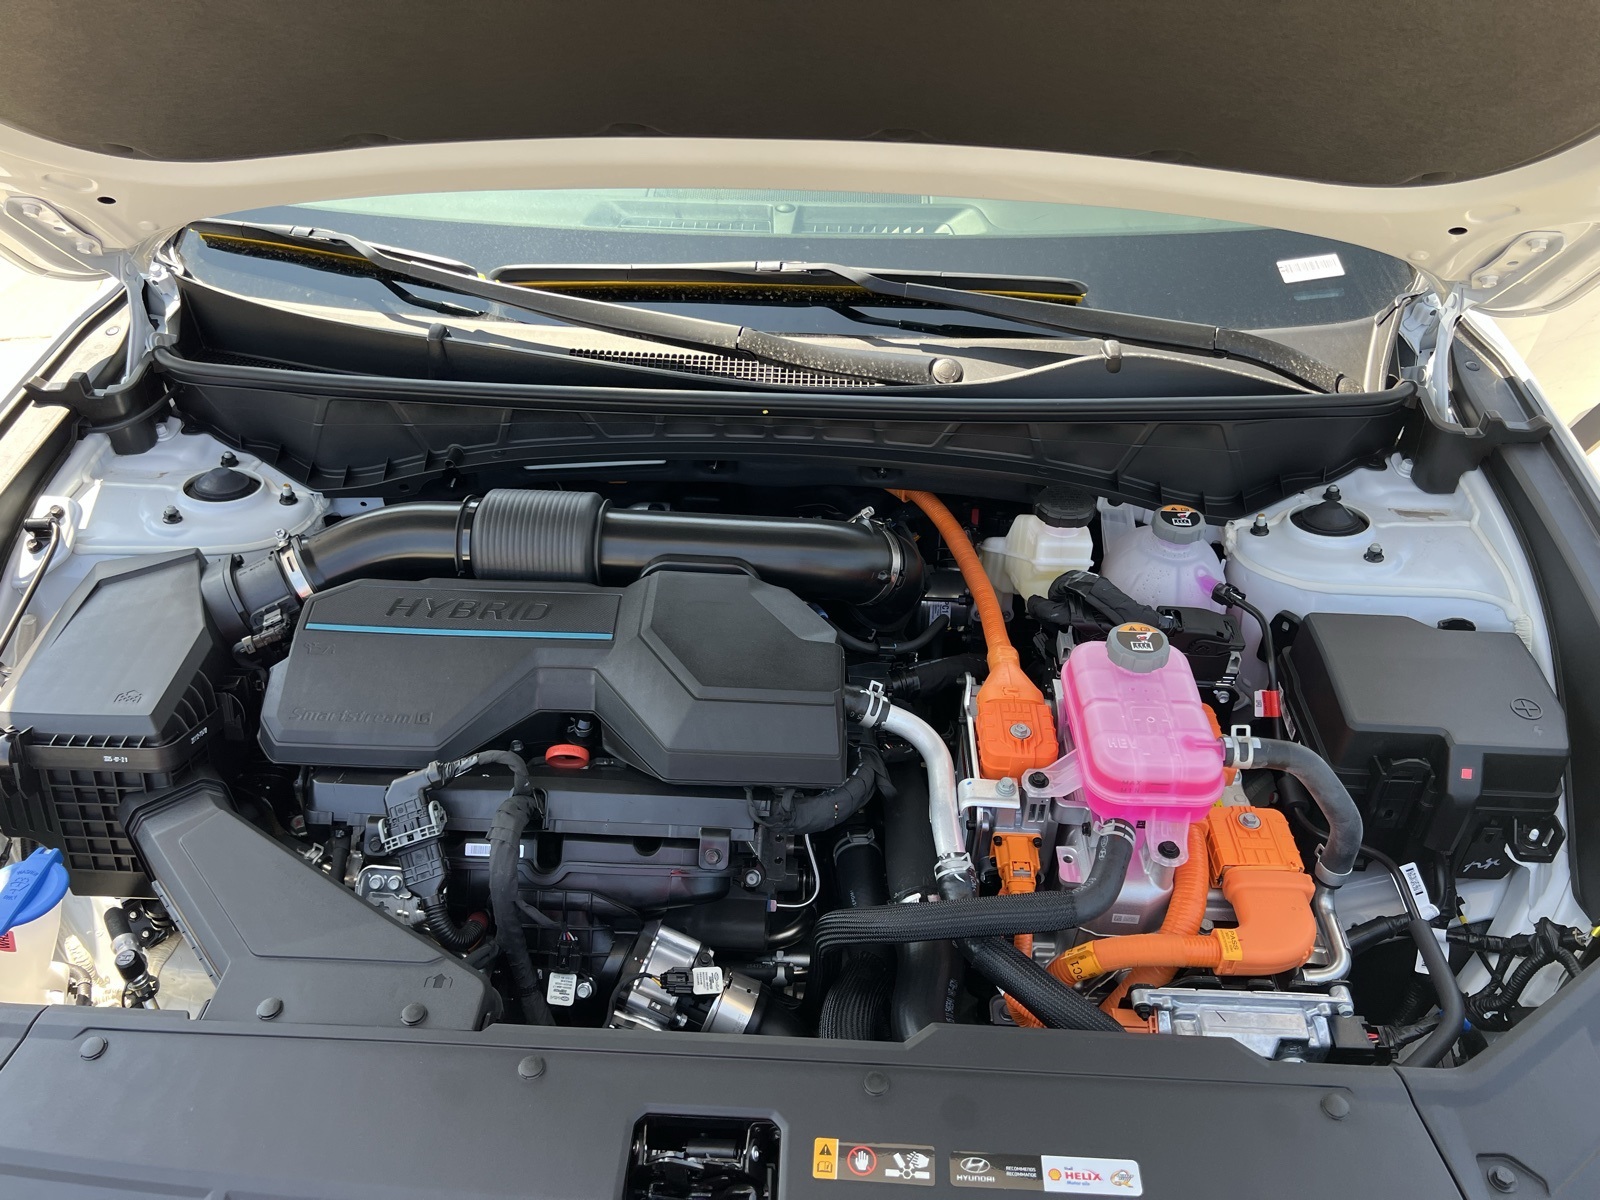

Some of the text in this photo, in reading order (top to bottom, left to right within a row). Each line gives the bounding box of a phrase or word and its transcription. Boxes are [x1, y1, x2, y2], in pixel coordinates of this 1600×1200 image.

[384, 597, 553, 622] HYBRID
[288, 707, 413, 725] Smartstream
[956, 1174, 995, 1183] HYUNDAI
[1065, 1171, 1103, 1181] HELIX
